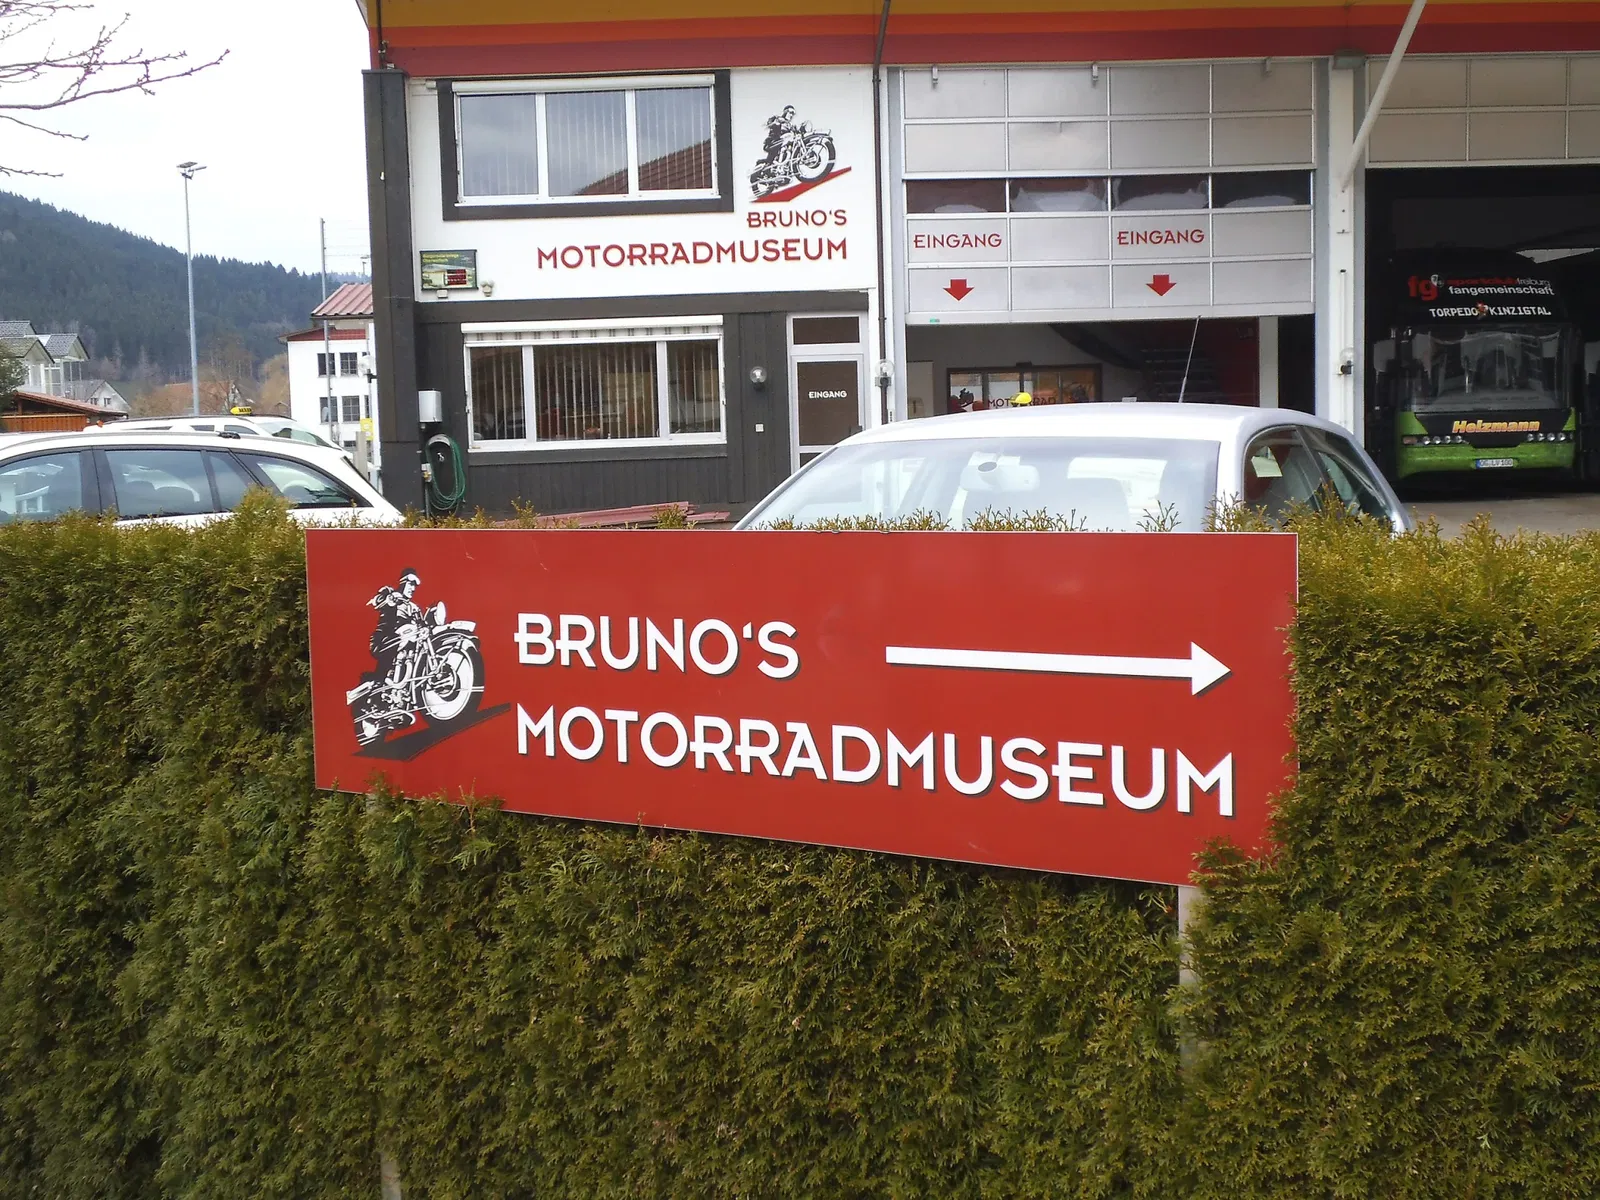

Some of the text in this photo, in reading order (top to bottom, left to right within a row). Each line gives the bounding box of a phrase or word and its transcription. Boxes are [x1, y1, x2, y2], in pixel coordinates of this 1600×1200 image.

[747, 209, 847, 228] BRUNO'S
[913, 233, 1003, 249] EINGANG
[1117, 229, 1205, 246] EINGANG
[537, 237, 847, 269] MOTORRADMUSEUM
[1448, 285, 1555, 296] fangemeinschaft
[1429, 306, 1552, 318] TORPEDO KINZIGTAL
[808, 390, 848, 399] EINGANG
[988, 396, 1058, 407] MOTRAD
[514, 613, 800, 680] BRUNO'S
[516, 702, 1235, 818] MOTORRADMUSEUM
